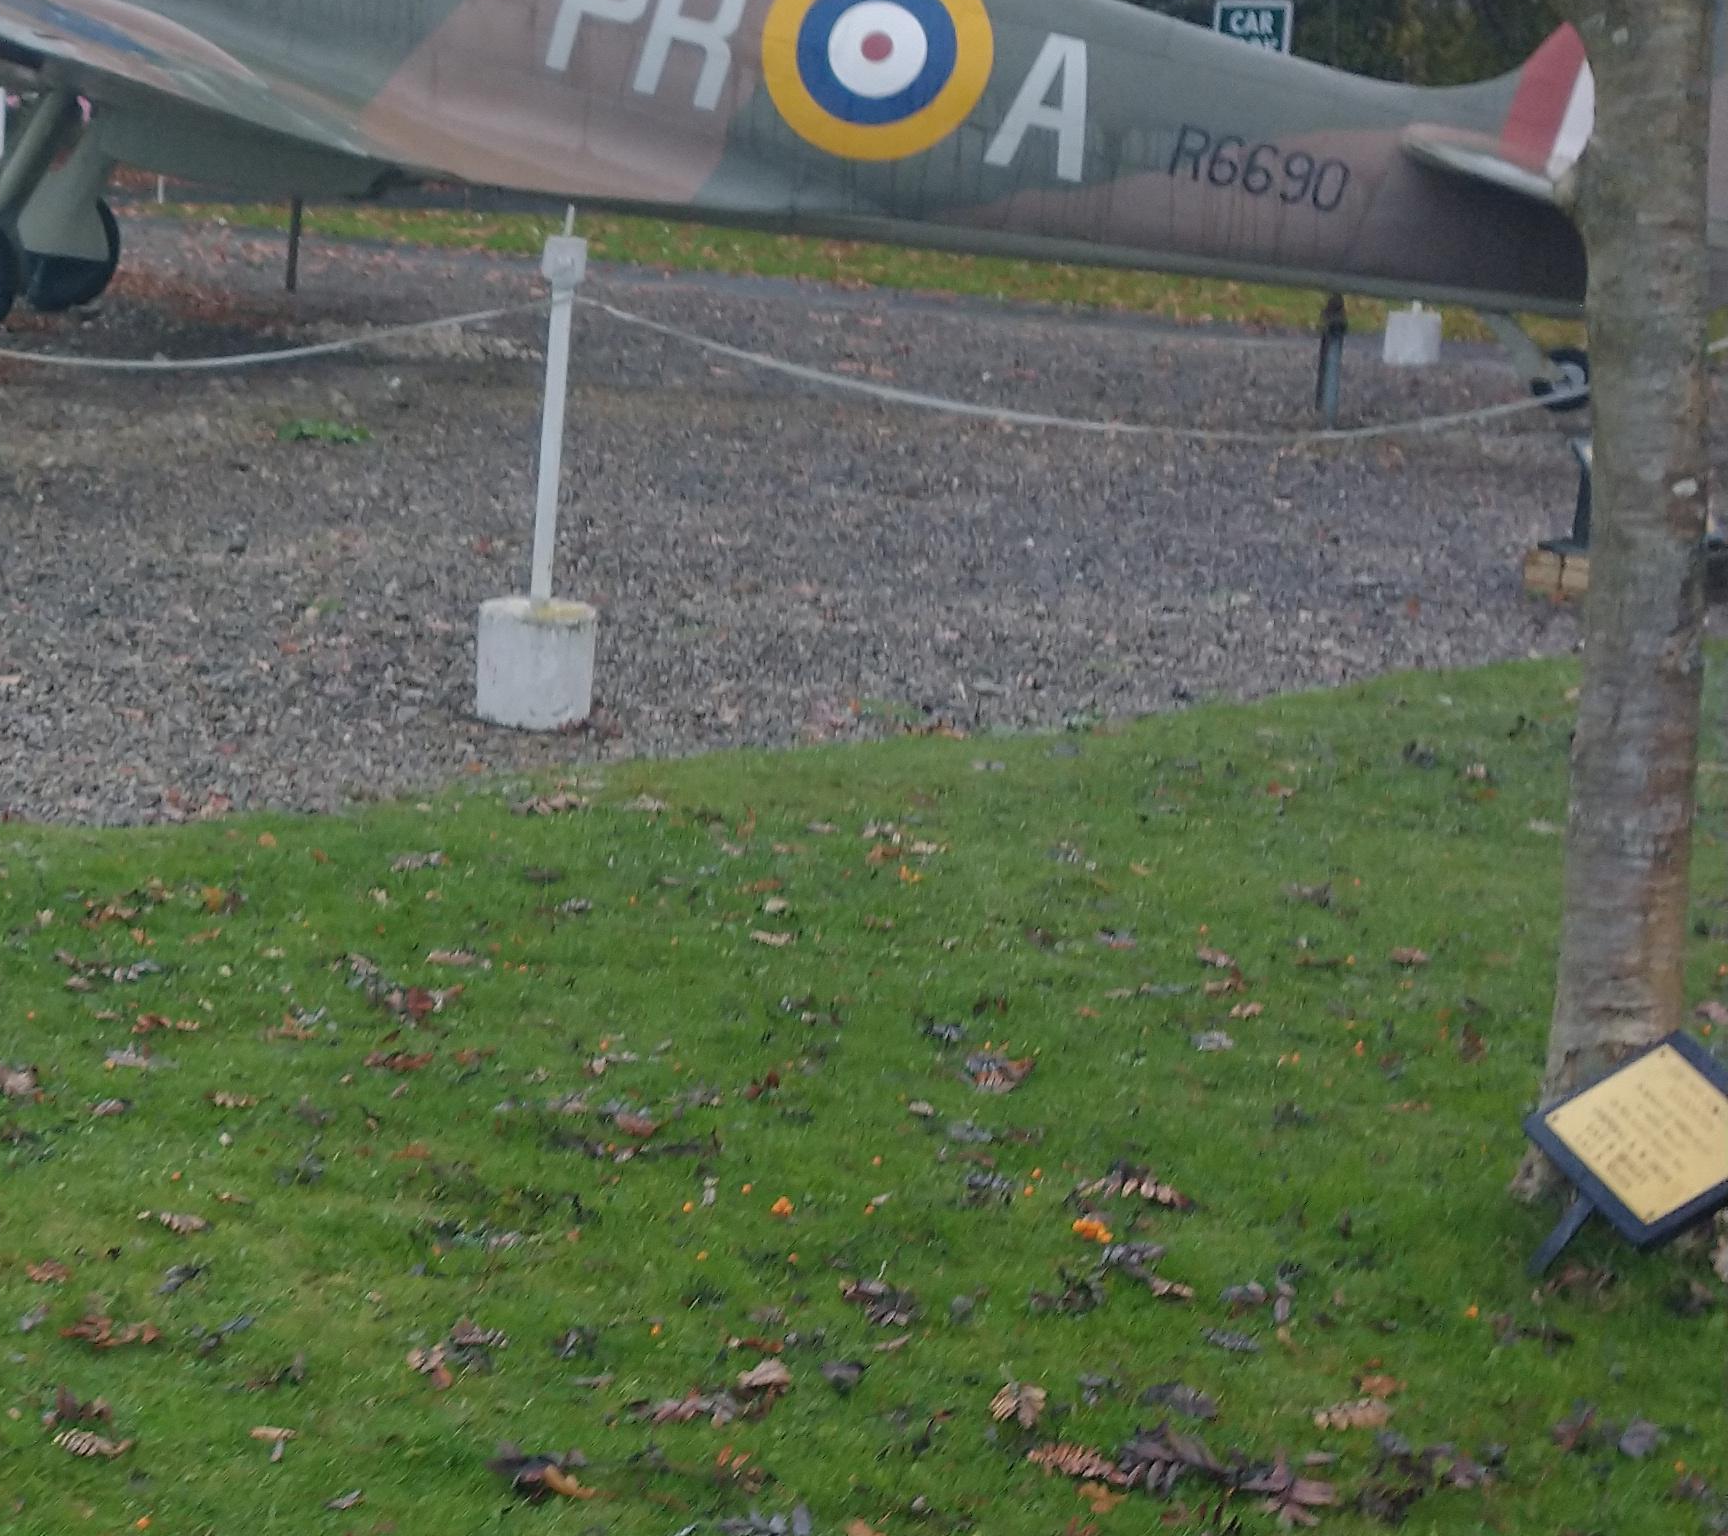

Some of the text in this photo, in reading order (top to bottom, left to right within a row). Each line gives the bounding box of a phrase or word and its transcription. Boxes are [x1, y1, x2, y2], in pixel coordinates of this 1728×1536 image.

[1230, 9, 1275, 35] CAR
[984, 33, 1088, 182] A
[1168, 126, 1352, 213] R6690
